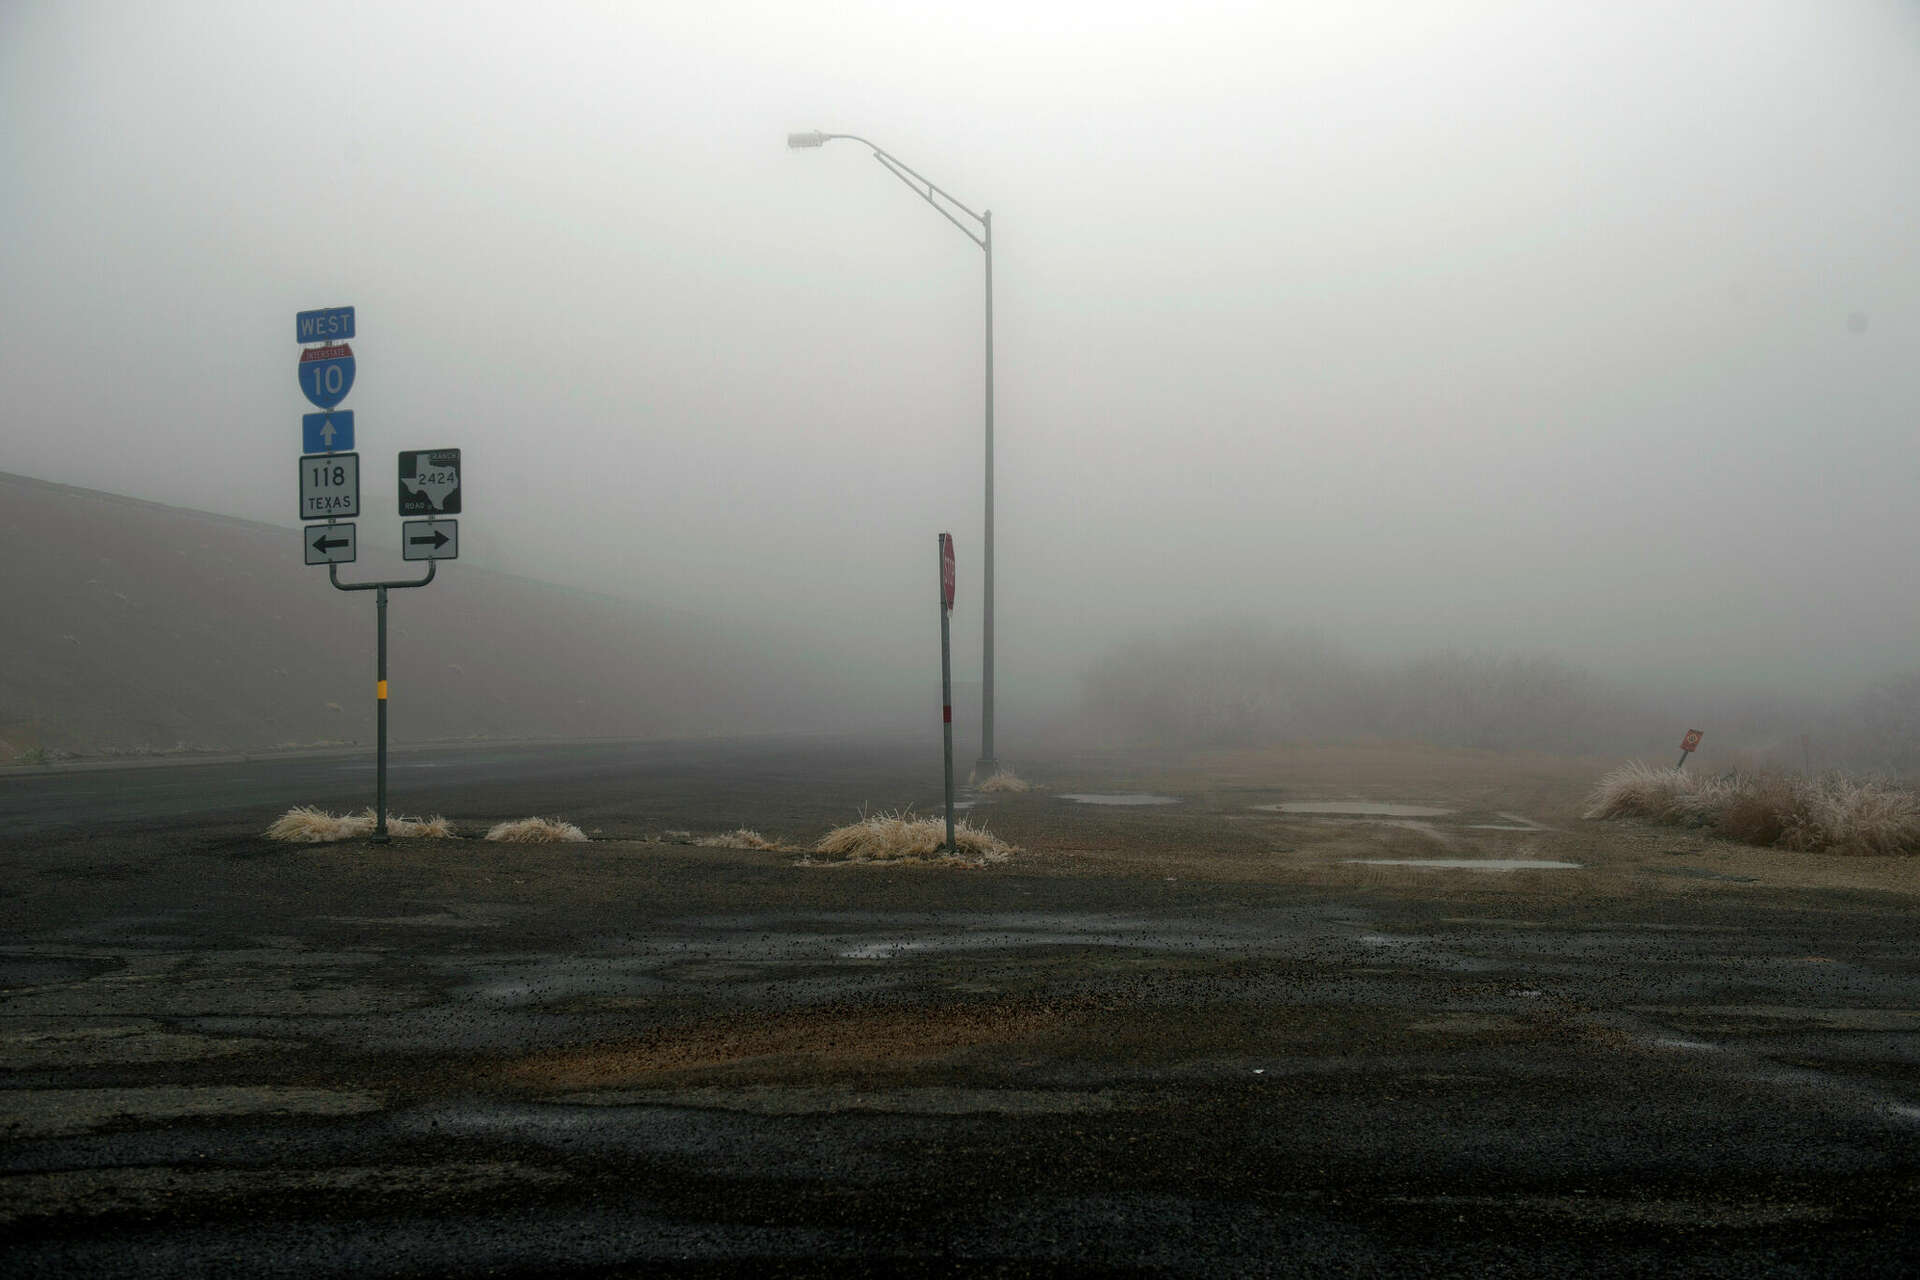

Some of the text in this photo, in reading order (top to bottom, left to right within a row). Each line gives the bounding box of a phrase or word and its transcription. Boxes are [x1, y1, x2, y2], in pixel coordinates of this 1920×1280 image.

[301, 314, 352, 336] WEST
[313, 364, 343, 396] 10
[313, 466, 345, 487] 118
[418, 471, 455, 485] 2424
[308, 495, 351, 510] TEXAS
